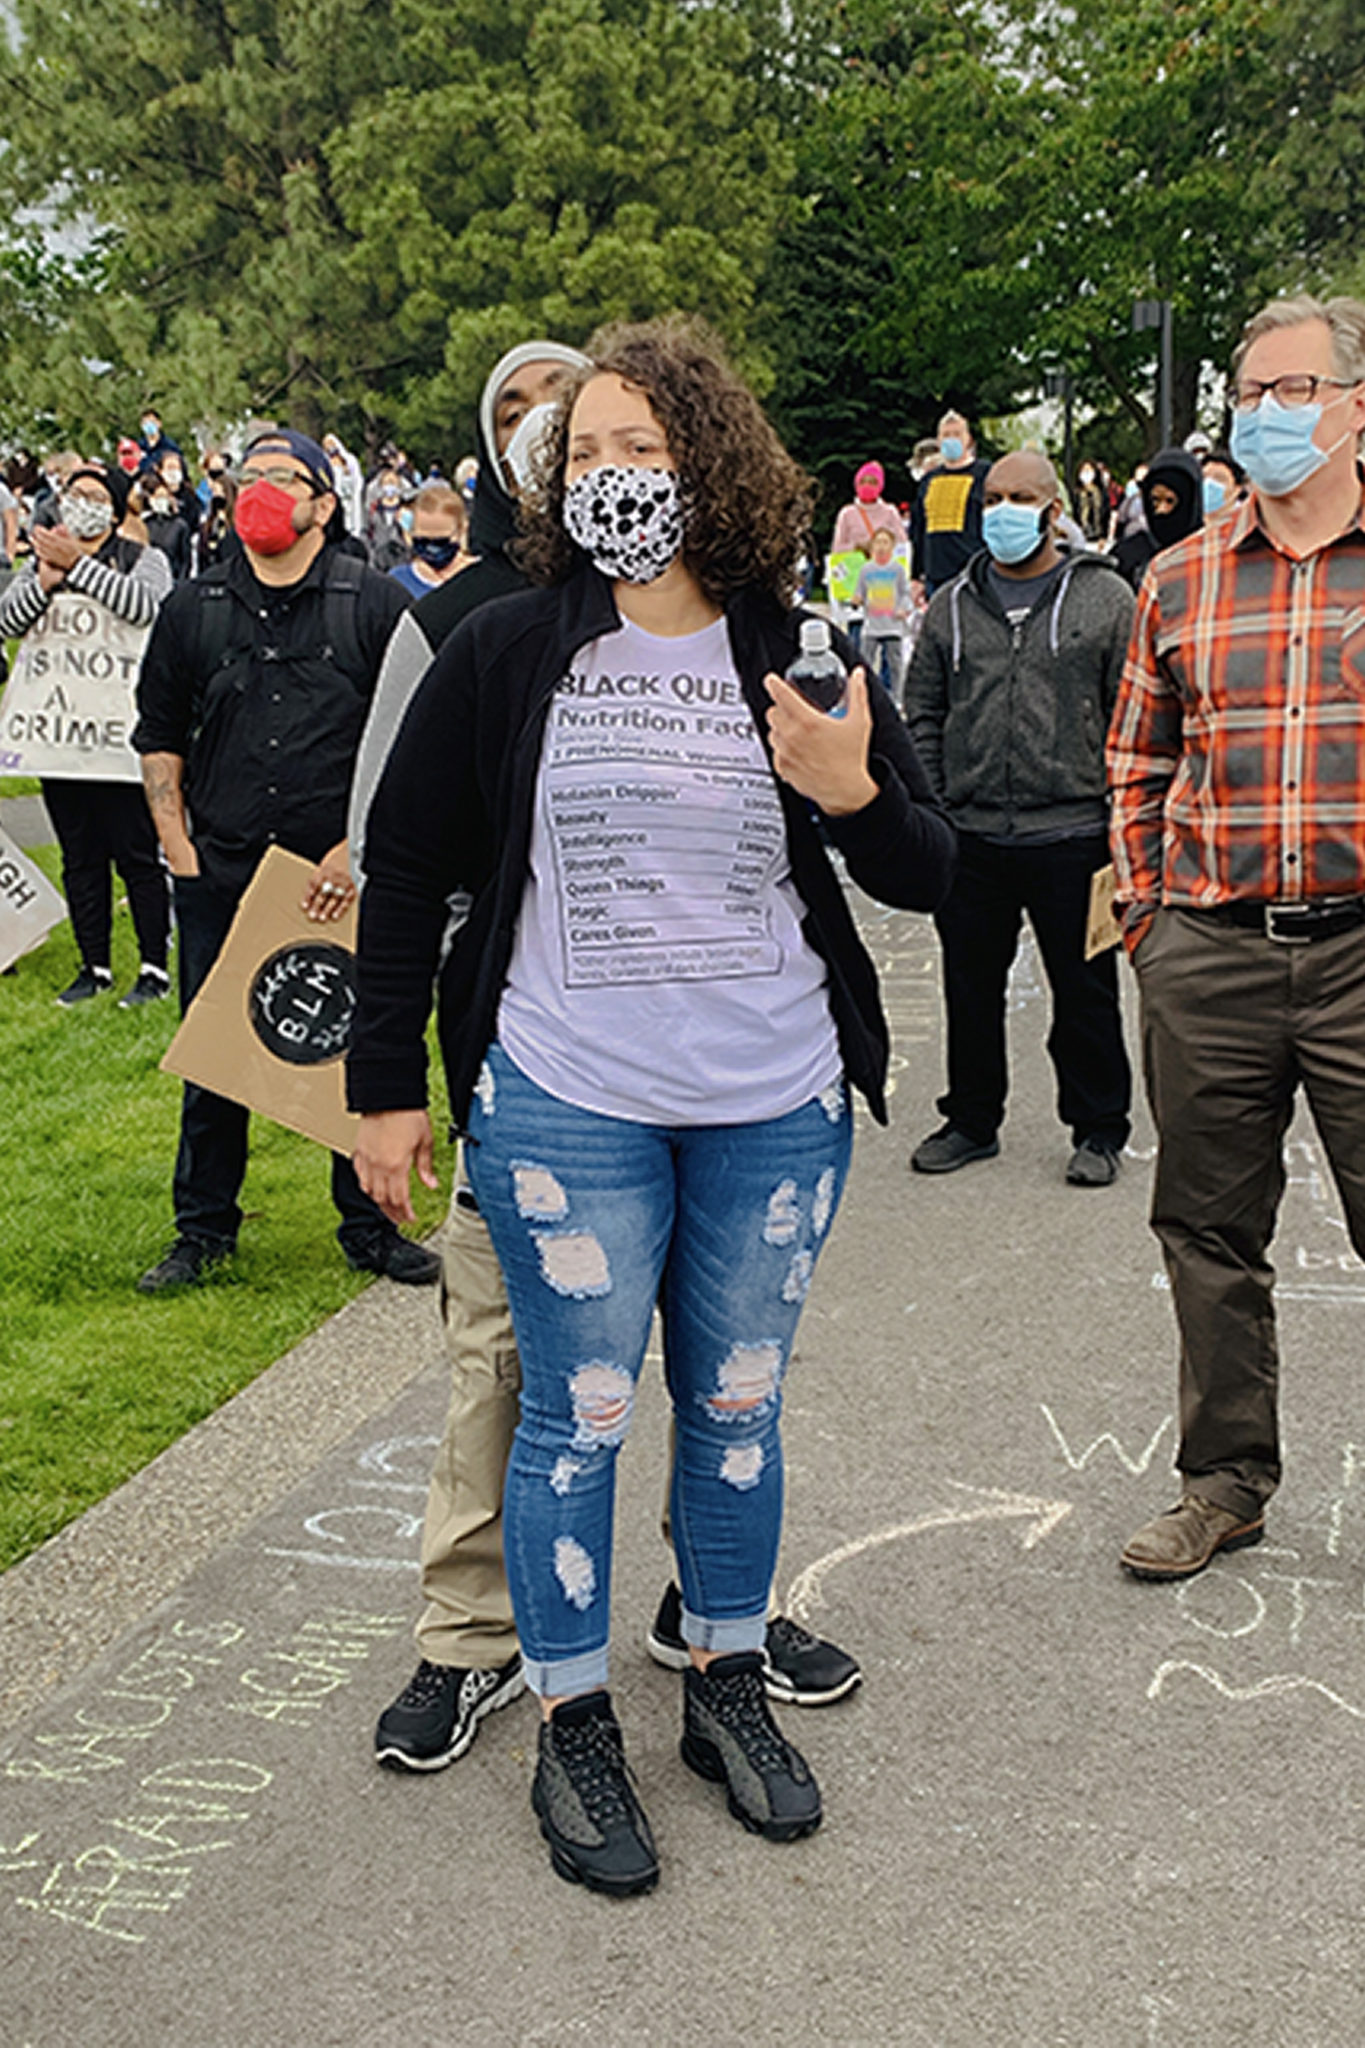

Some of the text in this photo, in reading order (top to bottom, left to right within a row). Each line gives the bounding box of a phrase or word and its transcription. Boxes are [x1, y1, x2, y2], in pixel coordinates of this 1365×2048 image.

[32, 606, 127, 645] OLOR
[24, 649, 137, 683] IS NOT
[44, 684, 68, 713] A
[556, 673, 743, 706] BLACK QUE
[8, 714, 126, 752] CRIME
[557, 707, 687, 734] Nutrition
[555, 810, 608, 827] Beauty
[559, 832, 647, 850] Intelligence
[0, 847, 37, 910] GH
[563, 856, 626, 875] Strength
[565, 877, 666, 899] Queen Things
[568, 905, 610, 921] Magic
[613, 924, 657, 940] Given
[276, 962, 340, 1044] BLM
[226, 1606, 408, 1730] AGAIN
